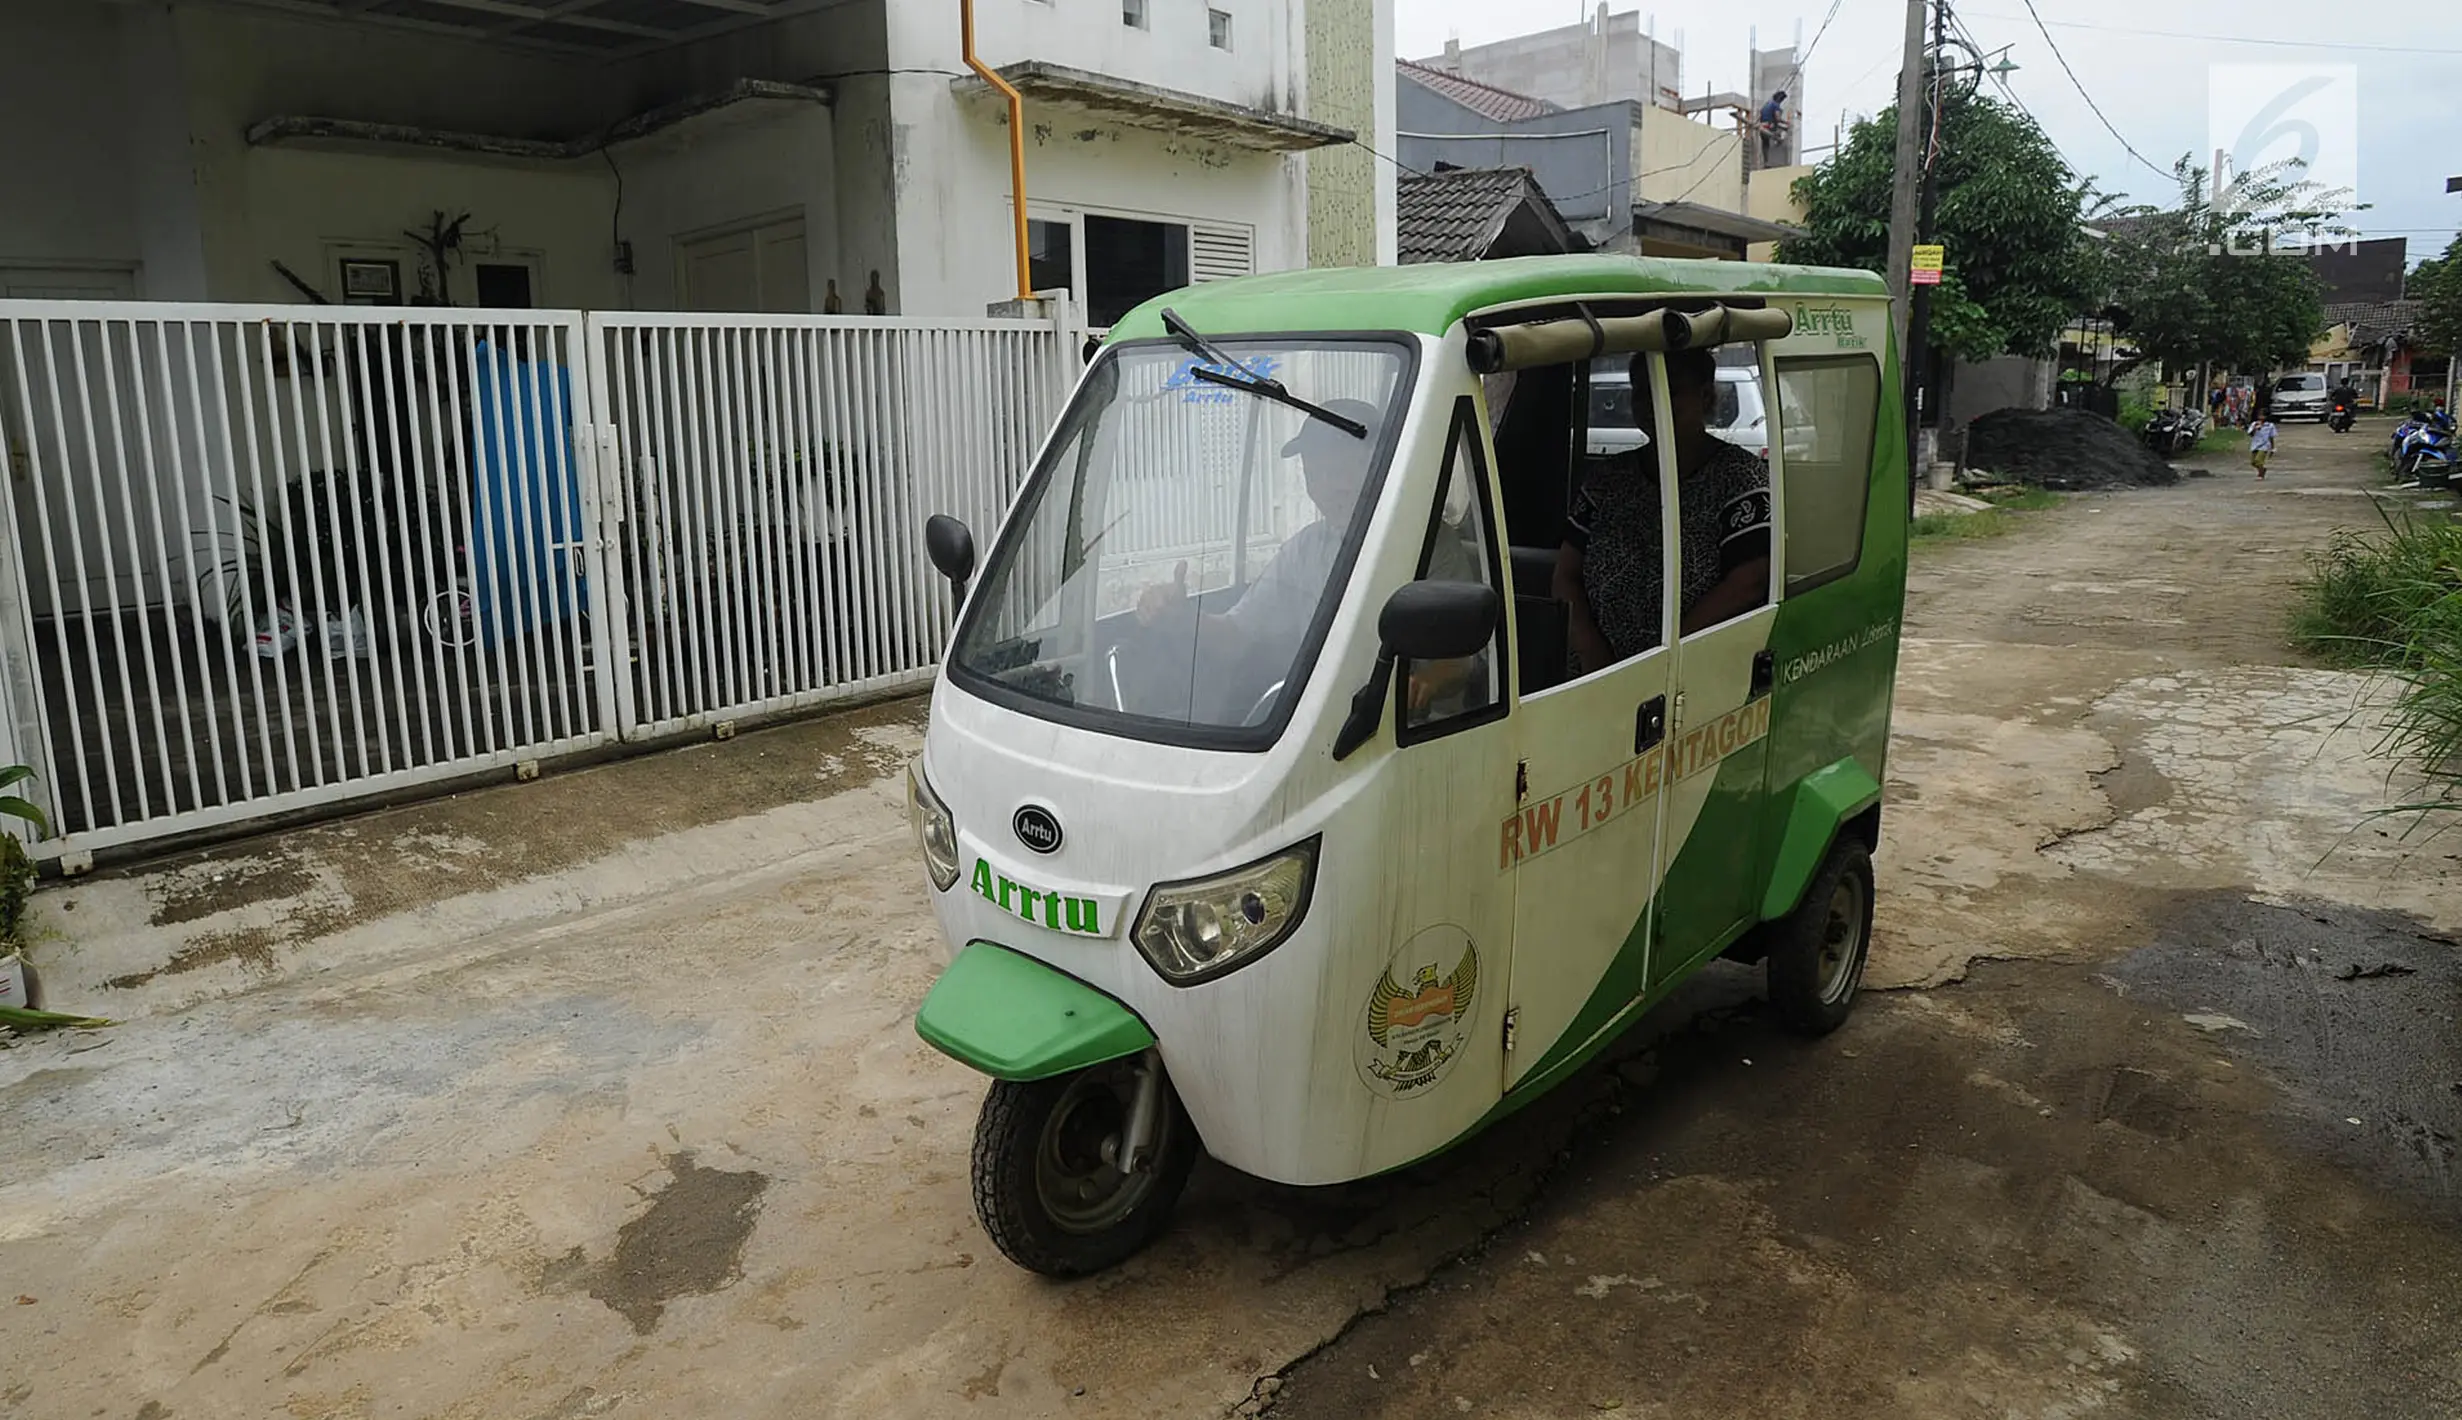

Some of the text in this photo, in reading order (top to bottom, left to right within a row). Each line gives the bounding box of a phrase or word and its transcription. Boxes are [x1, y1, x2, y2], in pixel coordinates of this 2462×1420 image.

[1794, 301, 1854, 336] Arrtu
[1183, 389, 1234, 404] Arrtu
[1783, 631, 1859, 685] KENDARAAN
[1500, 697, 1768, 870] RW 13 KENTAGOR
[1021, 817, 1053, 843] Arrtu
[970, 856, 1101, 935] Arrtu
